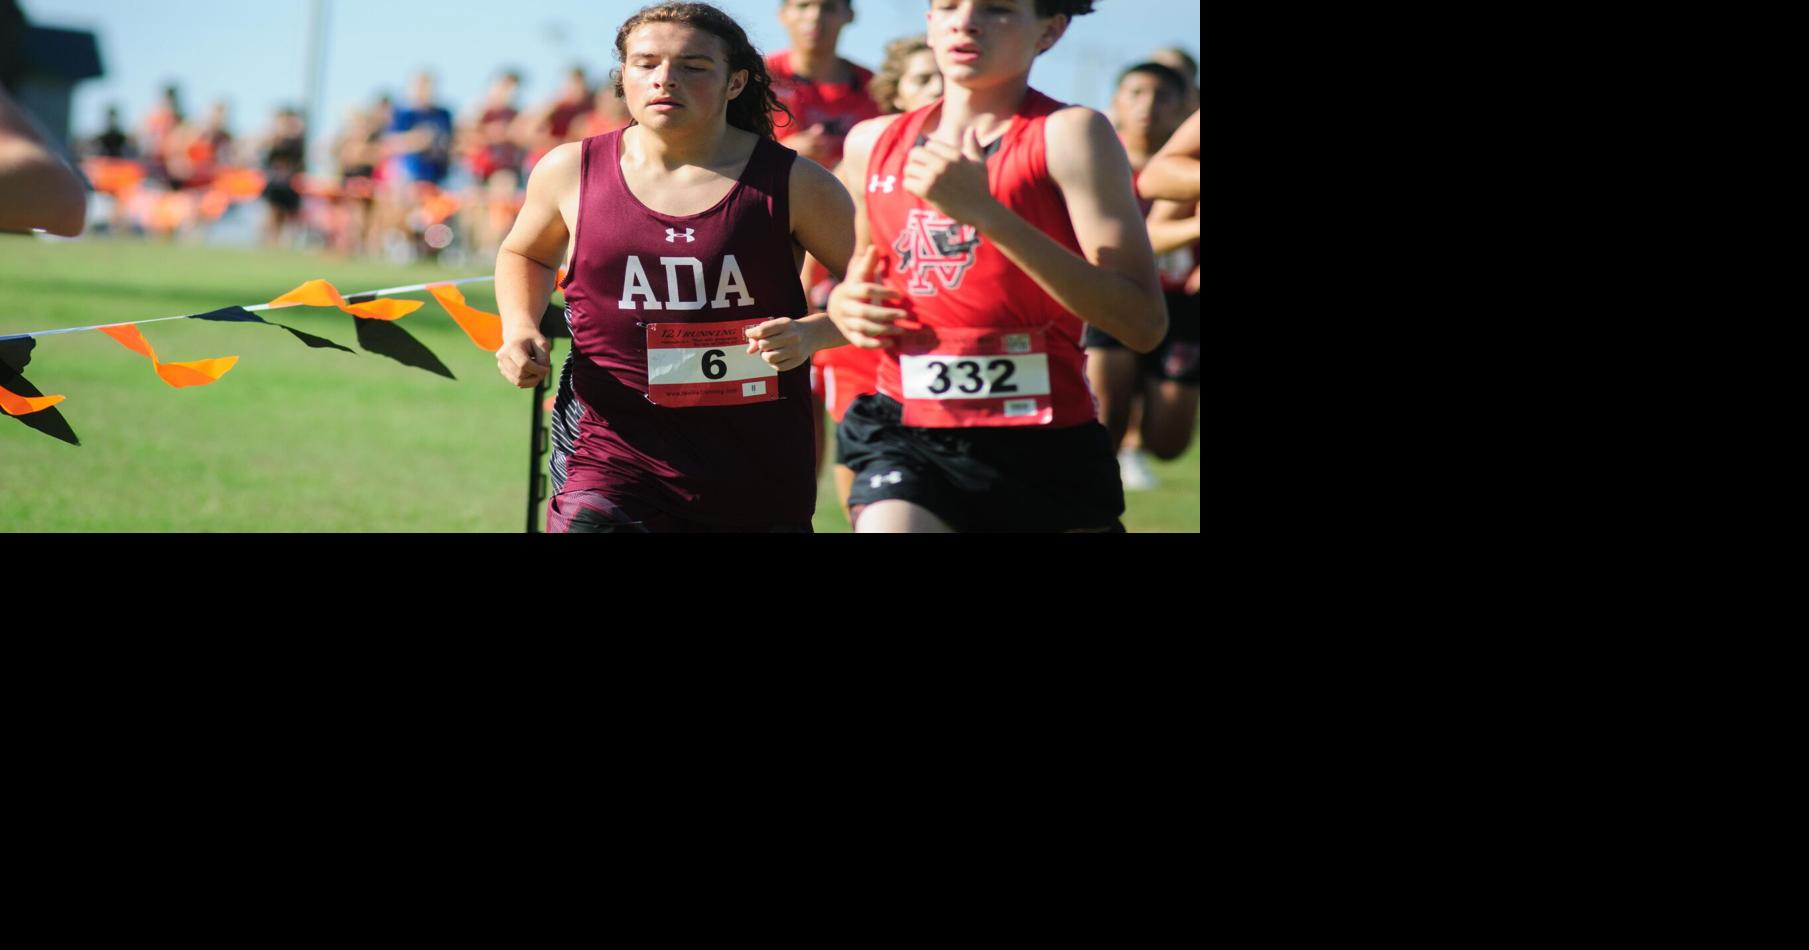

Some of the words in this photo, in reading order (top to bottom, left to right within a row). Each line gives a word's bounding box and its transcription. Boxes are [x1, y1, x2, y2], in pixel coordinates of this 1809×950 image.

[618, 254, 755, 310] ADA
[701, 349, 728, 380] 6
[927, 359, 1018, 394] 332
